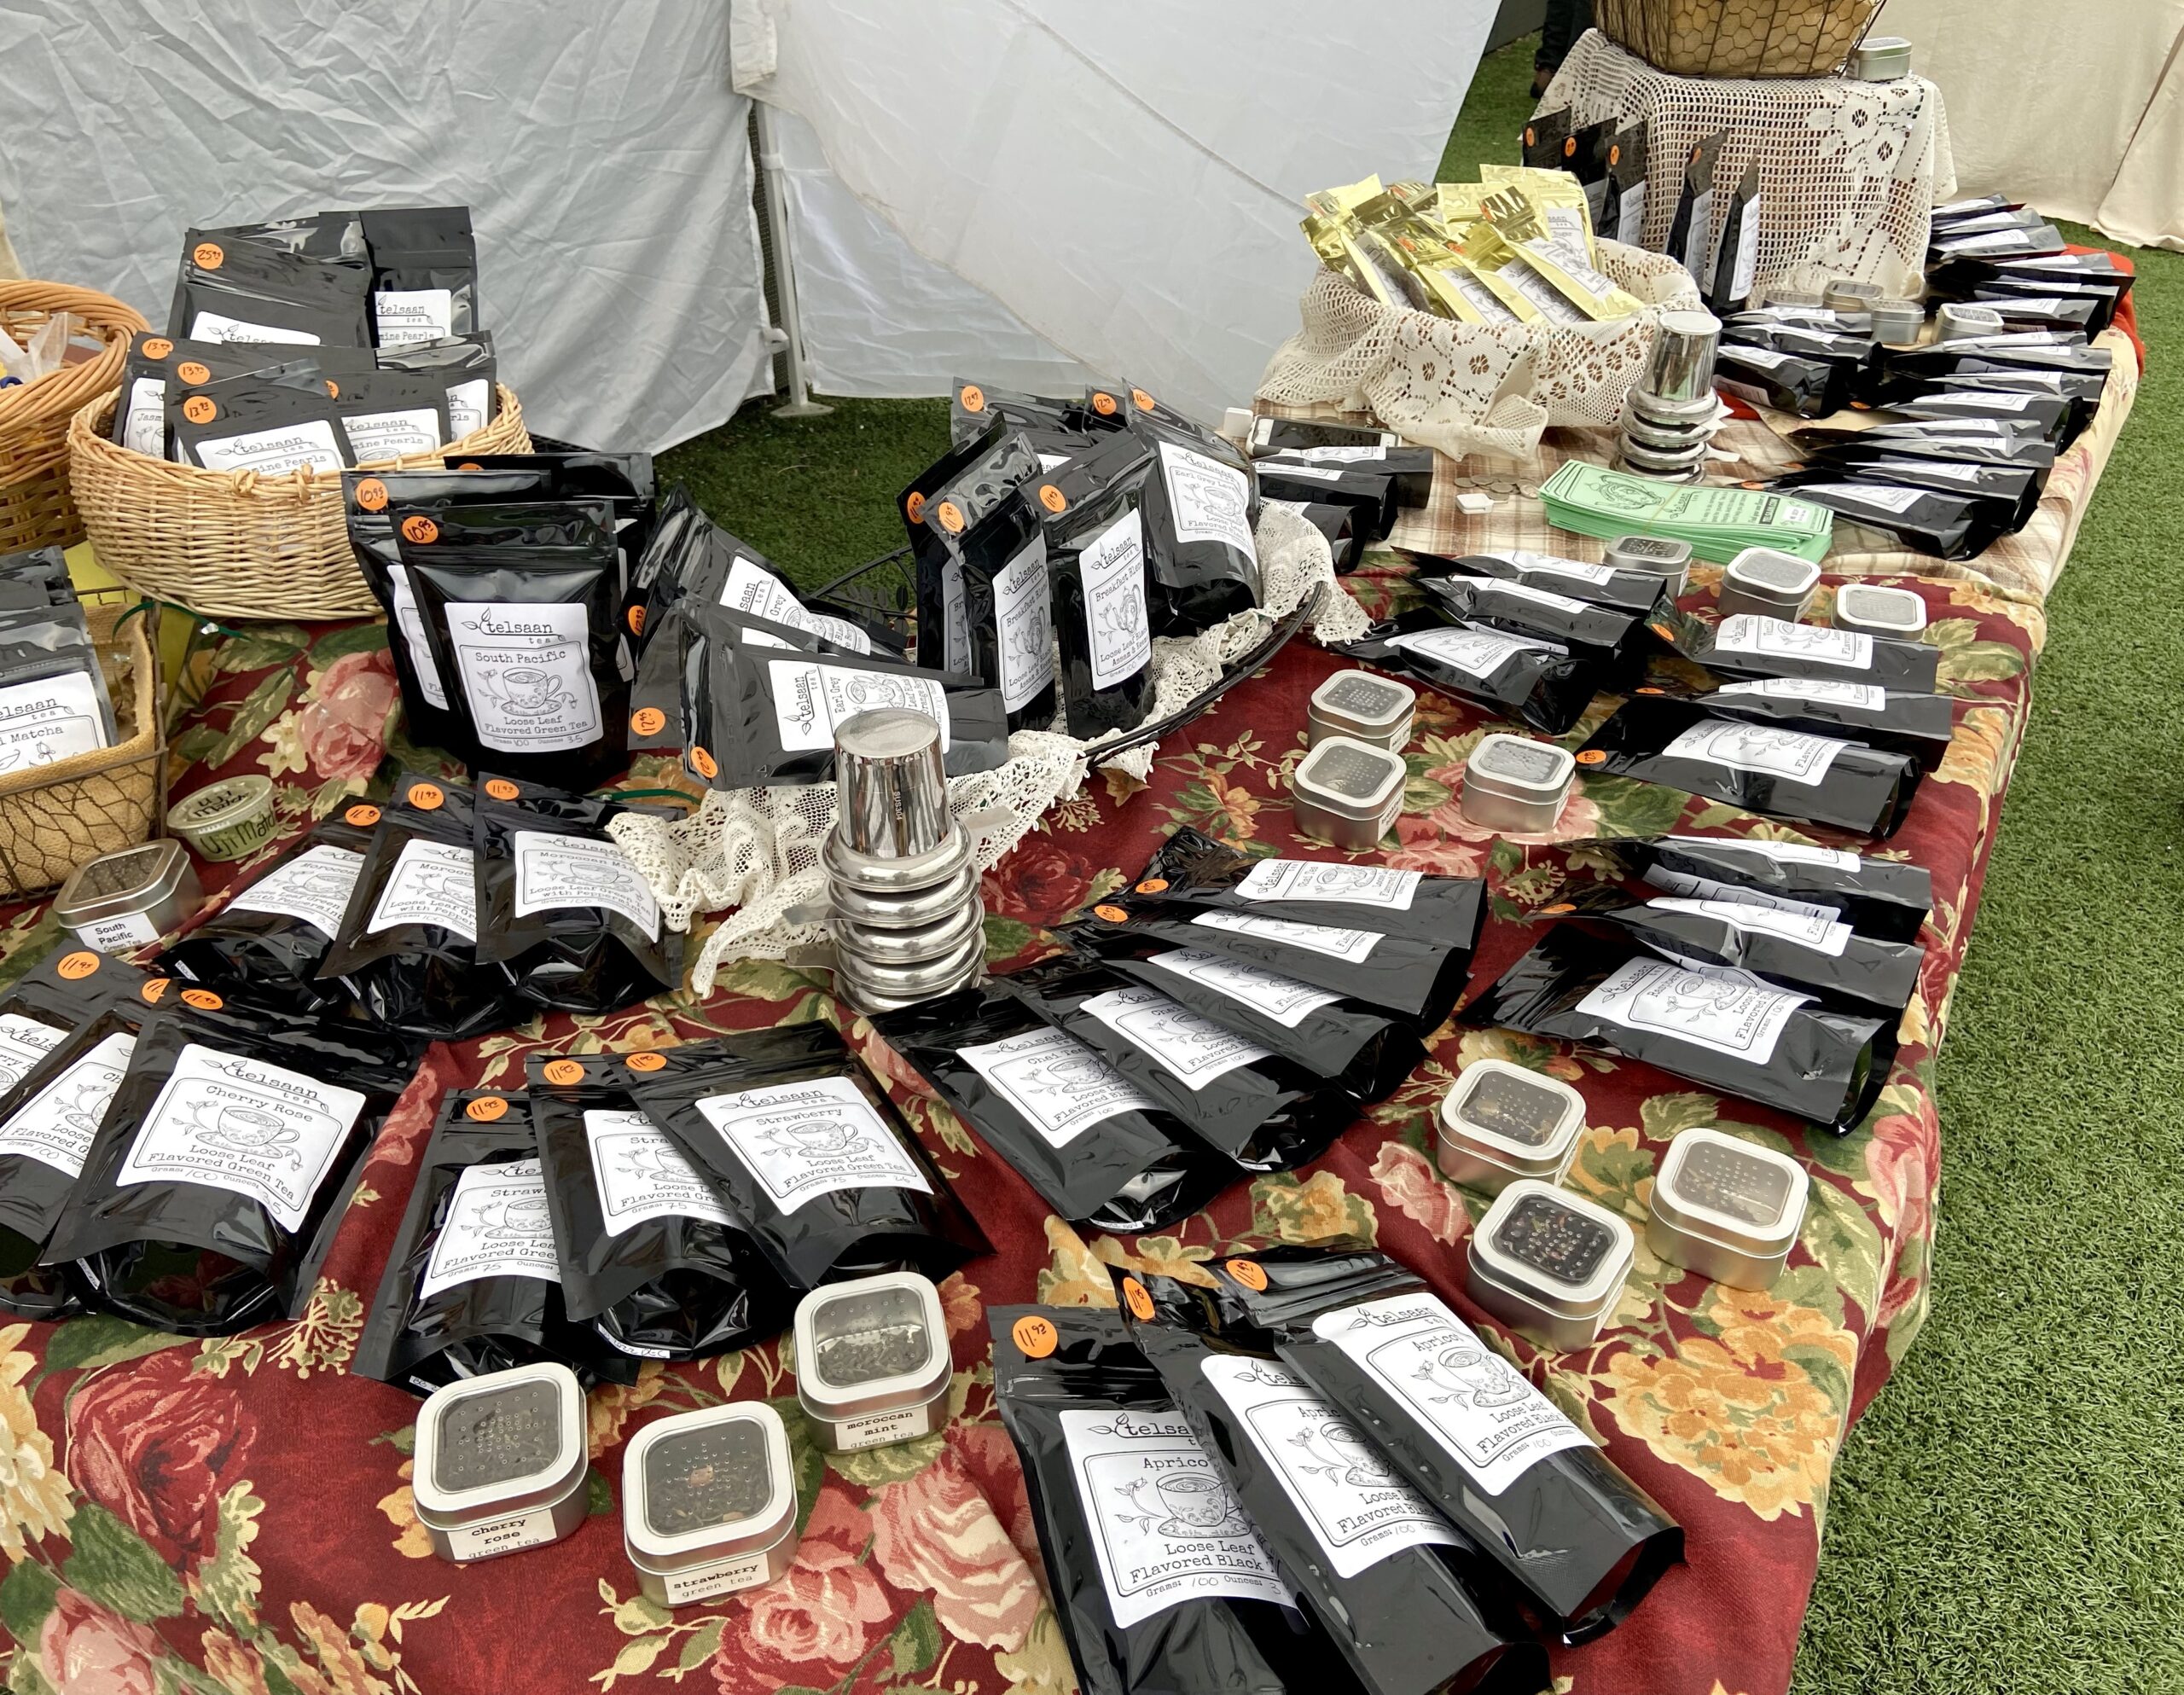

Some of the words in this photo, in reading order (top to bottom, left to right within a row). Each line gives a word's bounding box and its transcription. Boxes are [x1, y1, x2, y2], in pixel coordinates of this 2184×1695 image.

[380, 304, 425, 315] telsaan
[403, 330, 434, 341] Pearls
[241, 435, 303, 453] telsaan
[384, 436, 424, 446] Pearls
[284, 454, 328, 469] Pearls
[1175, 469, 1196, 479] Earl
[360, 486, 385, 503] 10.95
[944, 505, 956, 528] 11.95
[407, 520, 434, 541] 10.95
[1103, 536, 1133, 565] telsaan
[1013, 558, 1040, 589] telsaan
[1095, 572, 1129, 602] Breakfast
[770, 594, 787, 617] Grey
[1006, 596, 1036, 628] Breakfast
[486, 621, 554, 634] telsaan
[528, 636, 551, 644] tea
[475, 652, 514, 664] South
[517, 649, 566, 664] Pacific
[1100, 647, 1122, 663] Loose
[1121, 636, 1136, 653] Leaf
[1112, 651, 1131, 667] Assam
[828, 676, 841, 693] Grey
[1008, 671, 1028, 687] Loose
[795, 676, 812, 718] telsaan
[834, 693, 846, 714] Earl
[908, 690, 918, 708] Leaf
[32, 710, 56, 720] tea
[504, 717, 533, 726] Loose
[537, 715, 563, 725] Leaf
[10, 726, 64, 744] Matcha
[485, 723, 531, 735] Flavored
[535, 723, 566, 734] Green
[569, 719, 588, 729] Tea
[414, 790, 439, 804] 11.95
[539, 851, 607, 865] Moroccan
[612, 861, 637, 873] Min
[308, 895, 340, 909] Green
[389, 899, 428, 909] Loose
[429, 901, 458, 912] Leaf
[399, 904, 431, 914] with
[529, 885, 564, 895] Loose
[566, 884, 596, 893] Leaf
[600, 886, 633, 901] Green
[635, 899, 653, 917] Tea
[542, 889, 573, 898] with
[576, 889, 643, 915] Peppermint
[95, 922, 126, 936] South
[98, 931, 134, 946] Pacific
[62, 956, 92, 973] 11.95
[1620, 964, 1655, 990] telsaan
[1151, 1003, 1180, 1017] Chai
[1732, 992, 1754, 1015] Loose
[1734, 997, 1765, 1041] Flavored
[19, 1030, 56, 1051] tels
[1202, 1035, 1234, 1051] Loose
[1027, 1050, 1057, 1065] Chai
[1059, 1046, 1087, 1059] Tea
[1188, 1046, 1233, 1067] Flavored
[235, 1065, 318, 1100] telsaan
[206, 1085, 270, 1109] Cherry
[274, 1103, 314, 1123] Rose
[282, 1092, 311, 1106] tea
[751, 1088, 824, 1106] telsaan
[801, 1097, 827, 1106] tea
[1072, 1088, 1106, 1103] Loose
[756, 1107, 843, 1126] Strawberry
[1054, 1094, 1108, 1123] Flavored
[1096, 1106, 1115, 1117] 100
[12, 1128, 79, 1150] Flavored
[51, 1123, 92, 1144] Loose
[189, 1144, 236, 1161] Loose
[240, 1153, 276, 1172] Leaf
[806, 1157, 844, 1167] Loose
[845, 1153, 875, 1164] Leaf
[147, 1152, 224, 1169] Flavored
[228, 1160, 272, 1183] Green
[275, 1178, 295, 1201] Tea
[184, 1168, 218, 1182] 100
[783, 1164, 846, 1188] Flavored
[847, 1162, 886, 1172] Green
[887, 1163, 908, 1172] Tea
[652, 1182, 695, 1193] Loose
[619, 1190, 691, 1207] Flavored
[480, 1239, 526, 1251] Loose
[444, 1248, 515, 1269] Flavored
[1234, 1262, 1257, 1286] 11.95
[1368, 1305, 1435, 1326] telsaan
[1017, 1323, 1048, 1348] 11.95
[1267, 1371, 1304, 1386] tels
[846, 1410, 915, 1431] moroccan
[1489, 1403, 1531, 1424] Loose
[863, 1421, 899, 1436] mint
[1125, 1419, 1190, 1437] telsa
[1475, 1417, 1531, 1454] Flavored
[1531, 1409, 1560, 1429] Black
[850, 1434, 887, 1448] green
[890, 1430, 915, 1440] tea
[1502, 1442, 1530, 1463] Grams:
[1142, 1456, 1209, 1470] Aprico
[1362, 1491, 1402, 1506] Loose
[471, 1517, 527, 1537] cherry
[1336, 1503, 1407, 1534] Flavored
[483, 1530, 521, 1546] rose
[1360, 1528, 1392, 1547] Grams:
[1393, 1523, 1416, 1535] 100
[468, 1543, 508, 1559] green
[516, 1536, 541, 1547] tea
[1164, 1541, 1216, 1557] Loose
[1218, 1541, 1257, 1556] Leaf
[673, 1563, 758, 1589] strawberry
[1130, 1554, 1212, 1584] Flavored
[1217, 1553, 1265, 1572] Black
[682, 1582, 723, 1598] green
[729, 1575, 753, 1585] tea
[1145, 1581, 1182, 1599] Grams:
[1191, 1576, 1219, 1588] 100
[1223, 1574, 1263, 1586] Ounces:
